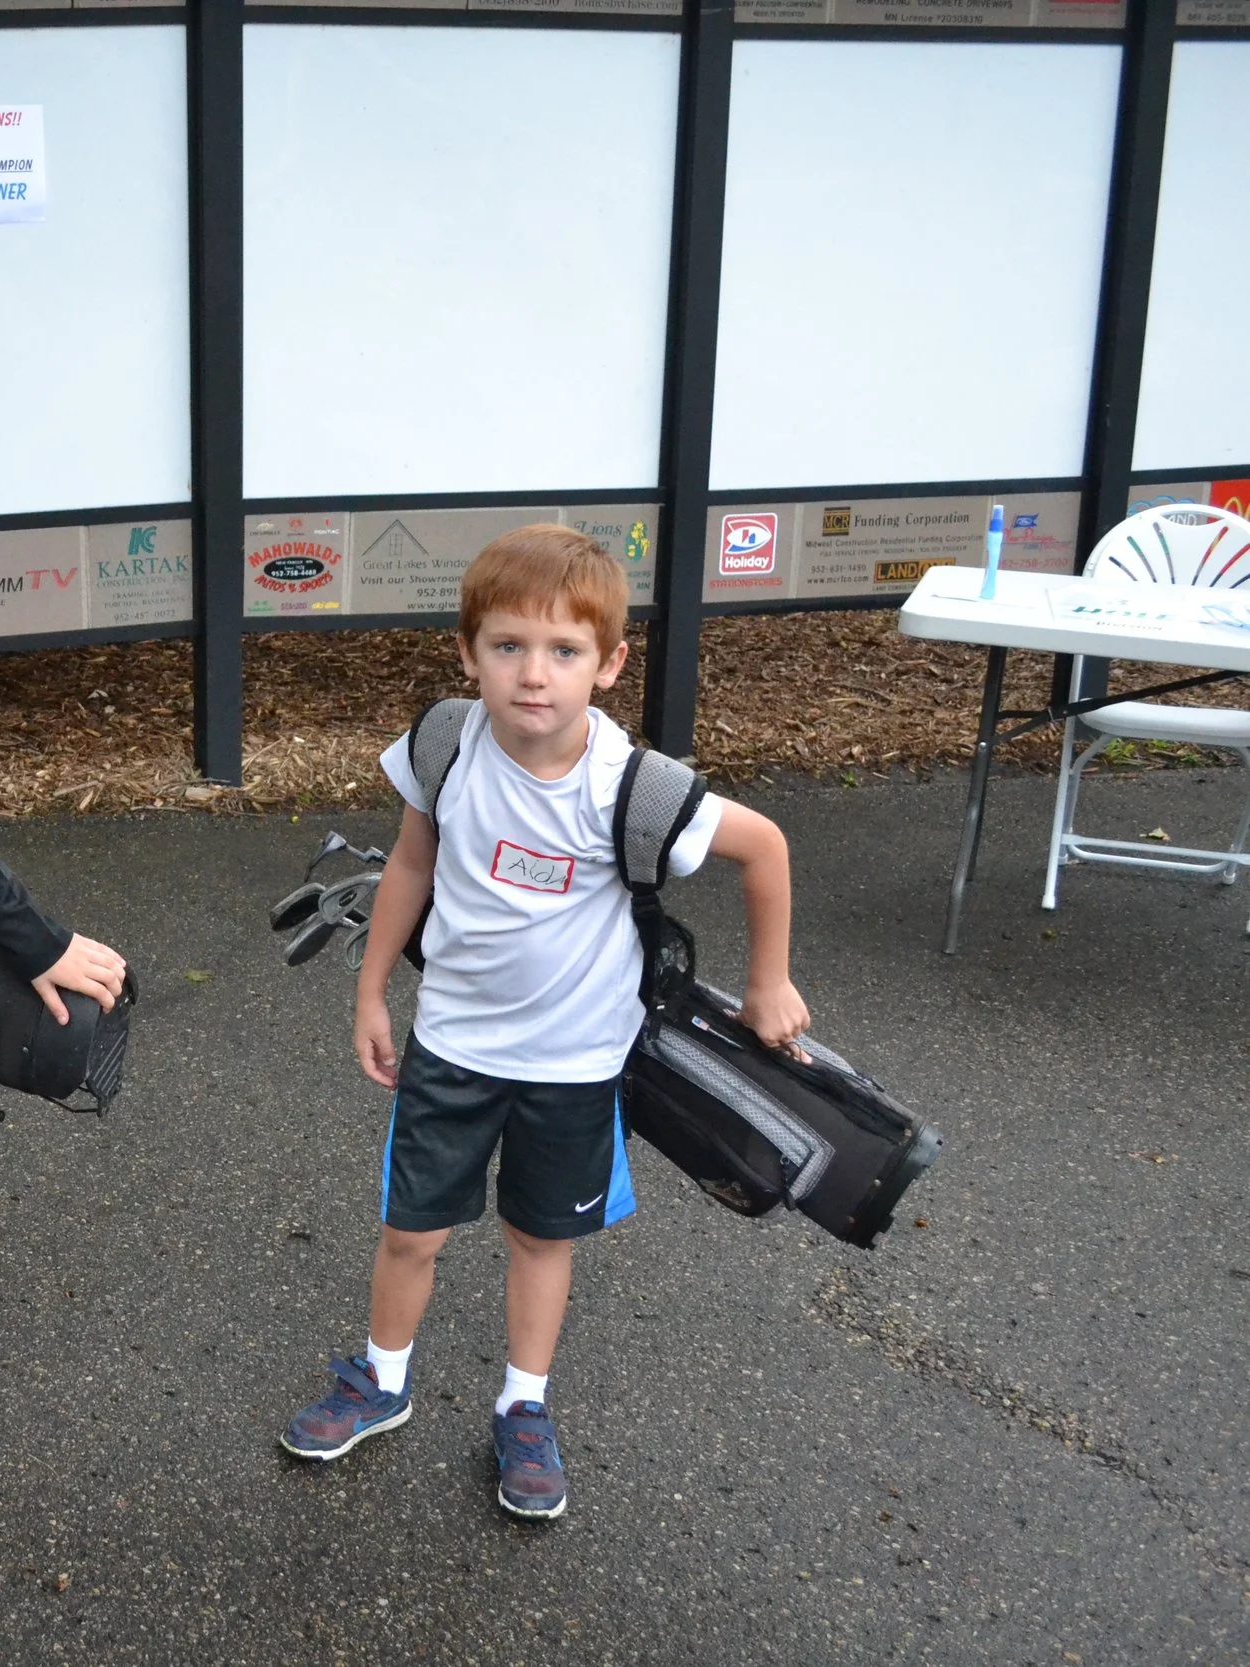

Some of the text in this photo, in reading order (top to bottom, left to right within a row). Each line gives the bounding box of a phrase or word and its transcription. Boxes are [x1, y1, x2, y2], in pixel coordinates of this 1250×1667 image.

[884, 12, 898, 21] MN
[823, 514, 850, 529] MCR
[854, 511, 970, 528] Funding Corporation
[248, 542, 342, 569] MAHOWALDS
[724, 556, 770, 569] Holiday
[96, 555, 189, 579] KARTAK
[362, 558, 471, 571] Great Lakes Windo
[25, 567, 79, 591] TV
[360, 576, 383, 586] Visit
[387, 577, 405, 585] our
